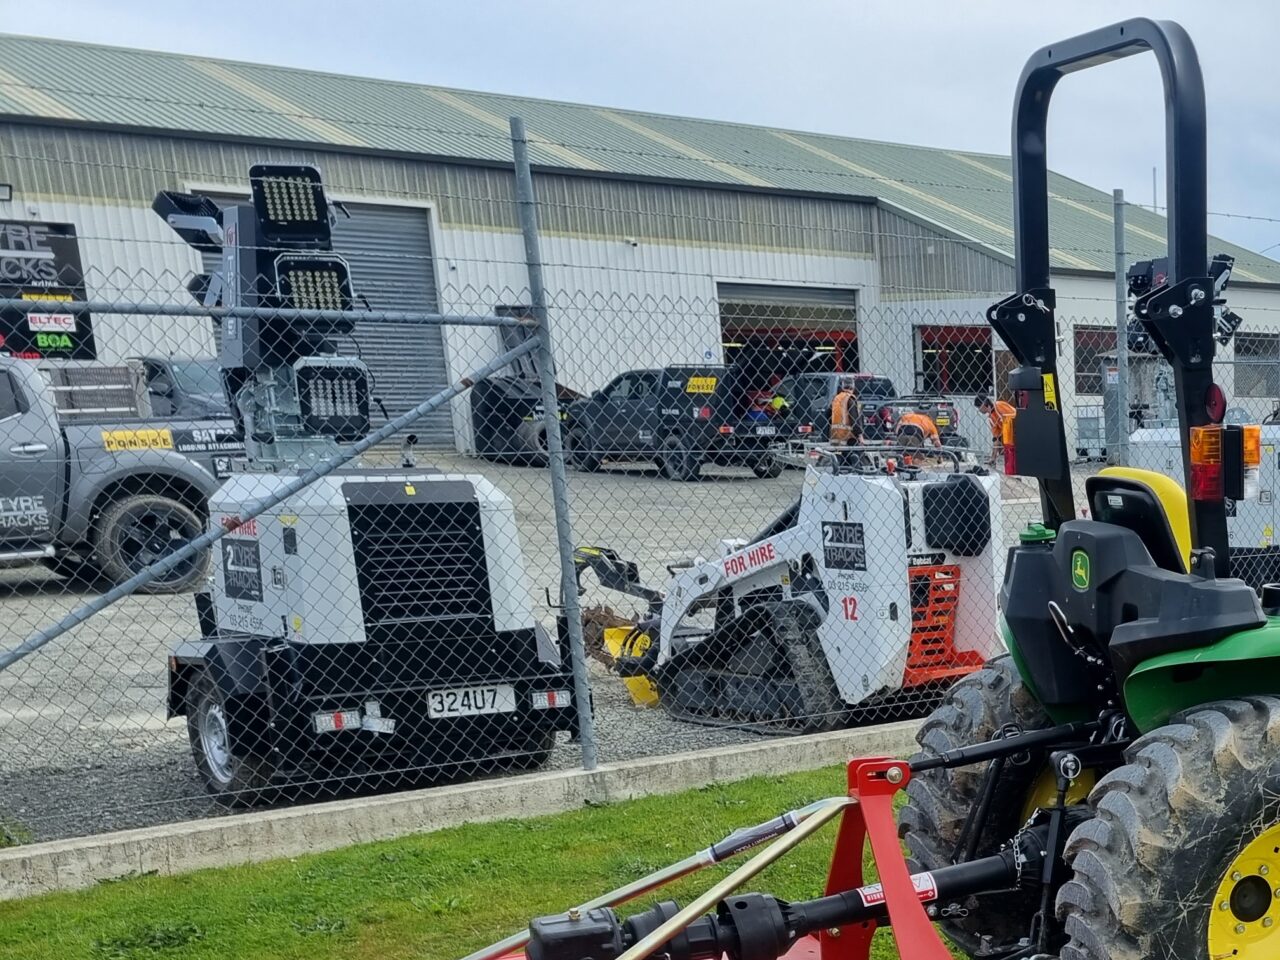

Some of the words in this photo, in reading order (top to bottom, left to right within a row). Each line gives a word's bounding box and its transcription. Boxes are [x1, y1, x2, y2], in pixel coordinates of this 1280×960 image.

[0, 223, 52, 252] RE
[0, 258, 58, 280] CKS
[29, 316, 73, 325] ELTEC
[36, 333, 73, 348] BOA
[106, 437, 170, 449] PONSSE
[724, 558, 747, 578] FOR
[750, 543, 775, 568] HIRE
[825, 548, 865, 562] TRACKS
[842, 596, 858, 621] 12
[431, 689, 497, 713] 324U7
